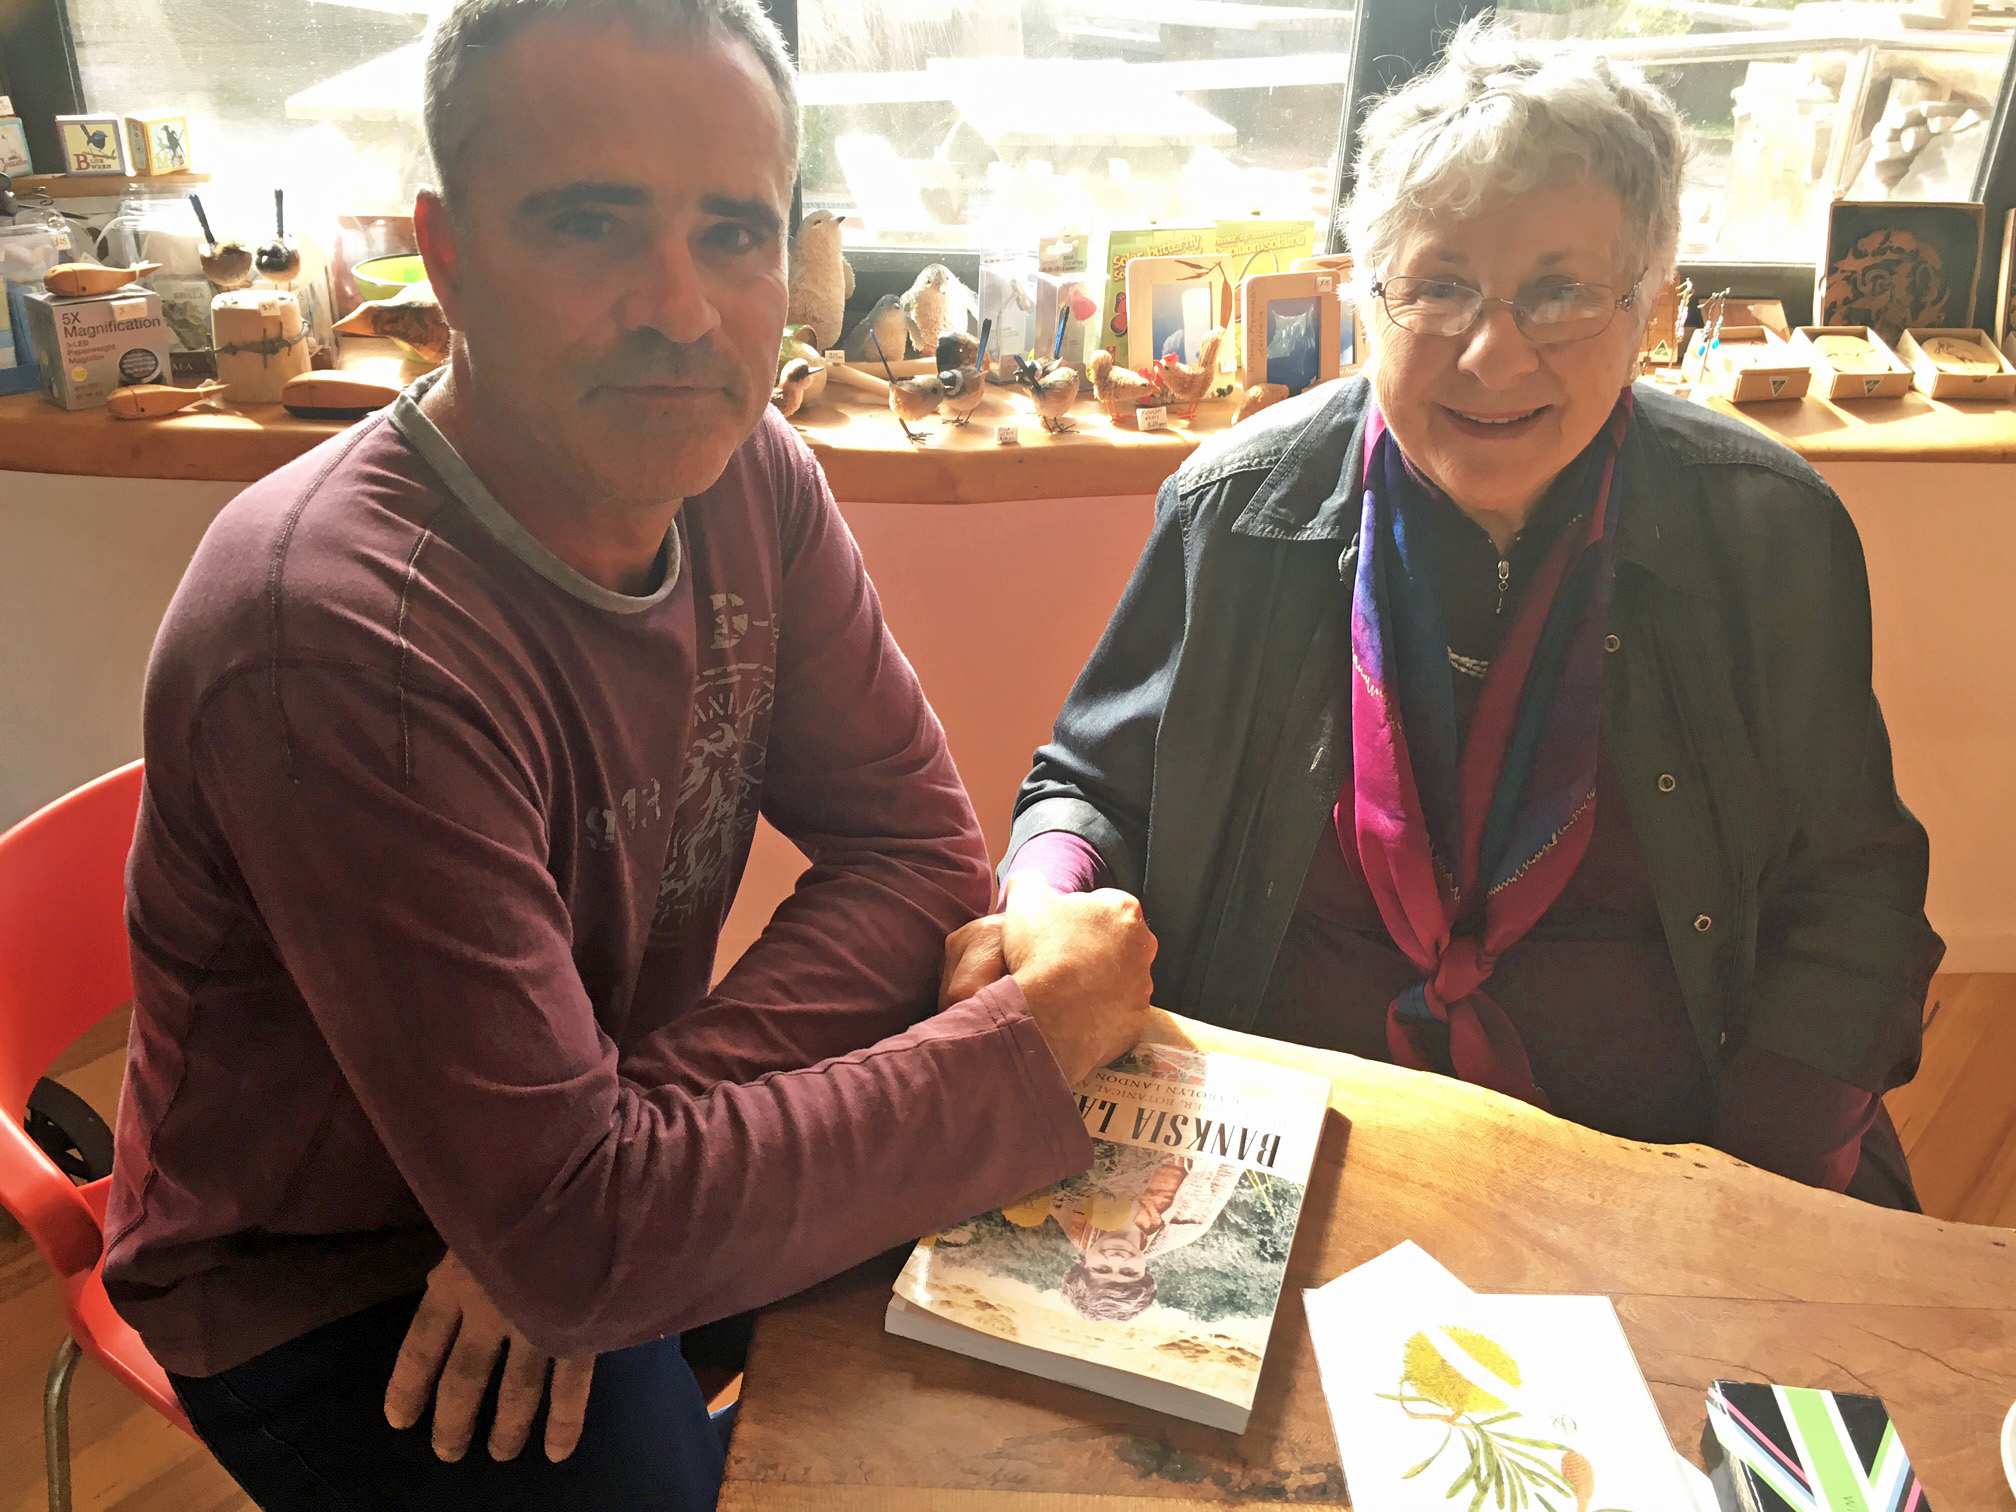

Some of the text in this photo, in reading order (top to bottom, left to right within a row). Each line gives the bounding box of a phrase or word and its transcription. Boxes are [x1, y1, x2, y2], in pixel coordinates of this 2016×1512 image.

[62, 312, 81, 325] 5X
[63, 317, 161, 339] Magnification
[1095, 1072, 1160, 1091] LANDON
[1097, 1085, 1175, 1106] BOTANICAL
[1073, 1090, 1120, 1134] LA
[1131, 1107, 1281, 1168] BANKSIA
